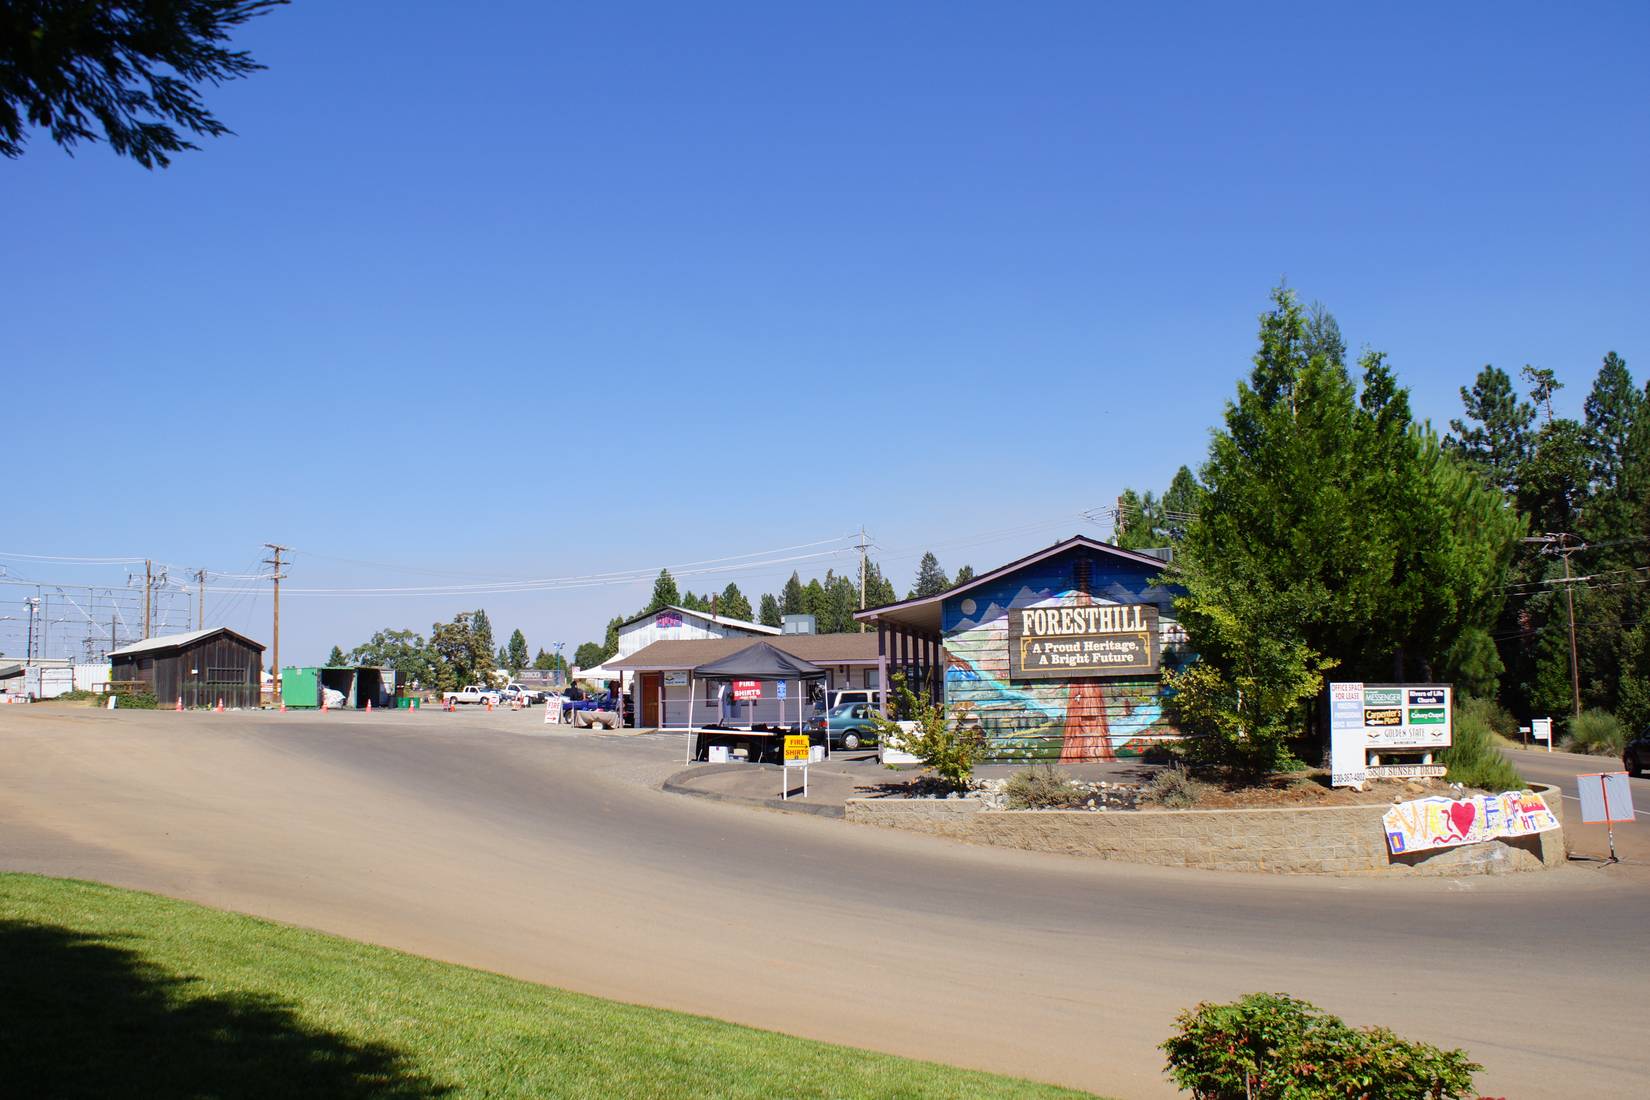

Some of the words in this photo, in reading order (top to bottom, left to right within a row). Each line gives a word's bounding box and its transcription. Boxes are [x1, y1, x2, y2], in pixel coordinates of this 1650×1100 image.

[1022, 605, 1147, 636] FORESTHILL
[1032, 643, 1041, 653] A
[1045, 642, 1081, 652] Proud
[1084, 640, 1139, 652] Heritage,
[1039, 655, 1048, 664] A
[1051, 653, 1090, 666] Bright
[1093, 652, 1134, 663] Future
[734, 689, 760, 697] SHIRTS
[1384, 728, 1406, 738] GOLDEN
[1408, 727, 1425, 738] STATE
[1389, 765, 1417, 776] SUNSET
[1420, 765, 1443, 775] DRIVE
